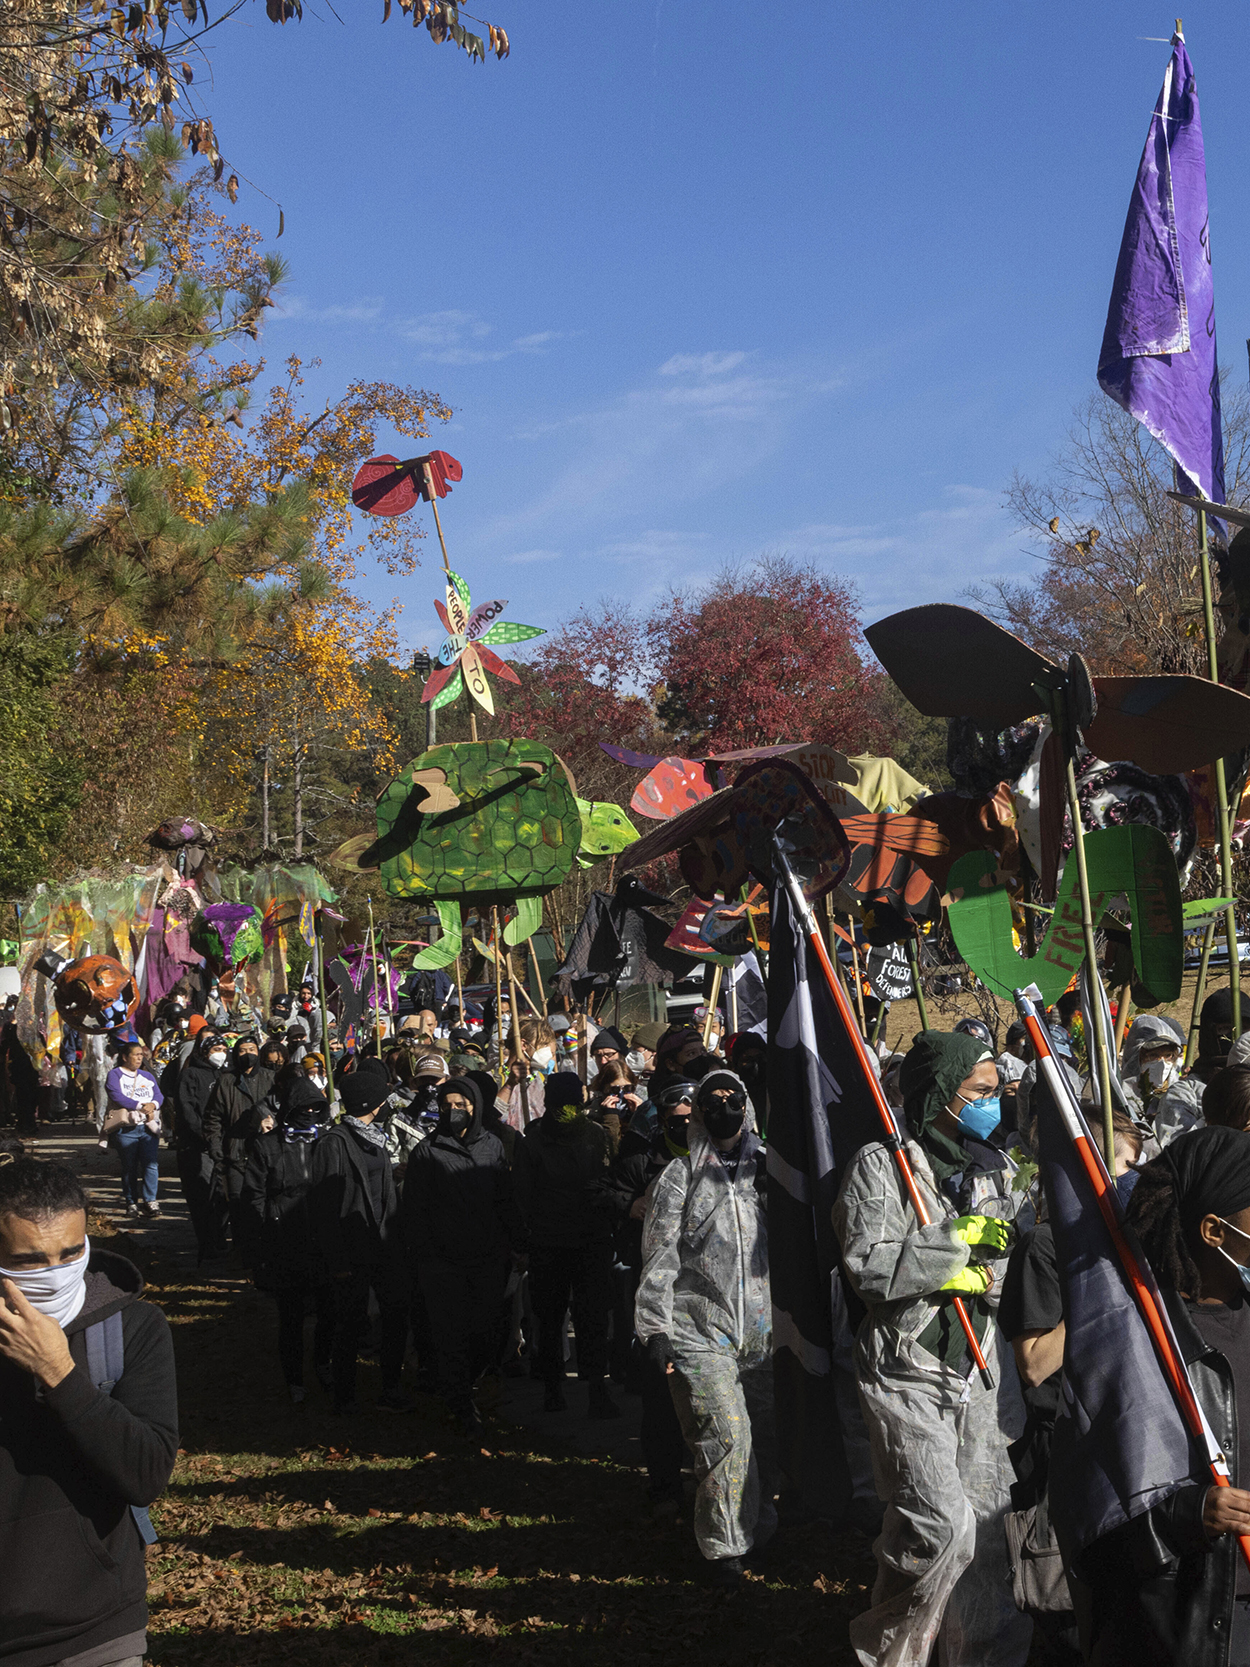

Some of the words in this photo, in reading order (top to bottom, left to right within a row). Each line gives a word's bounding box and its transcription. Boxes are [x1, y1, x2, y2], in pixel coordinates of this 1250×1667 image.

[447, 590, 466, 633] PEOPLE
[466, 600, 504, 640] POWER
[442, 638, 463, 661] THE
[469, 659, 485, 695] TO
[798, 753, 836, 781] STOP
[1043, 882, 1105, 973] FREE
[881, 958, 911, 982] FOREST
